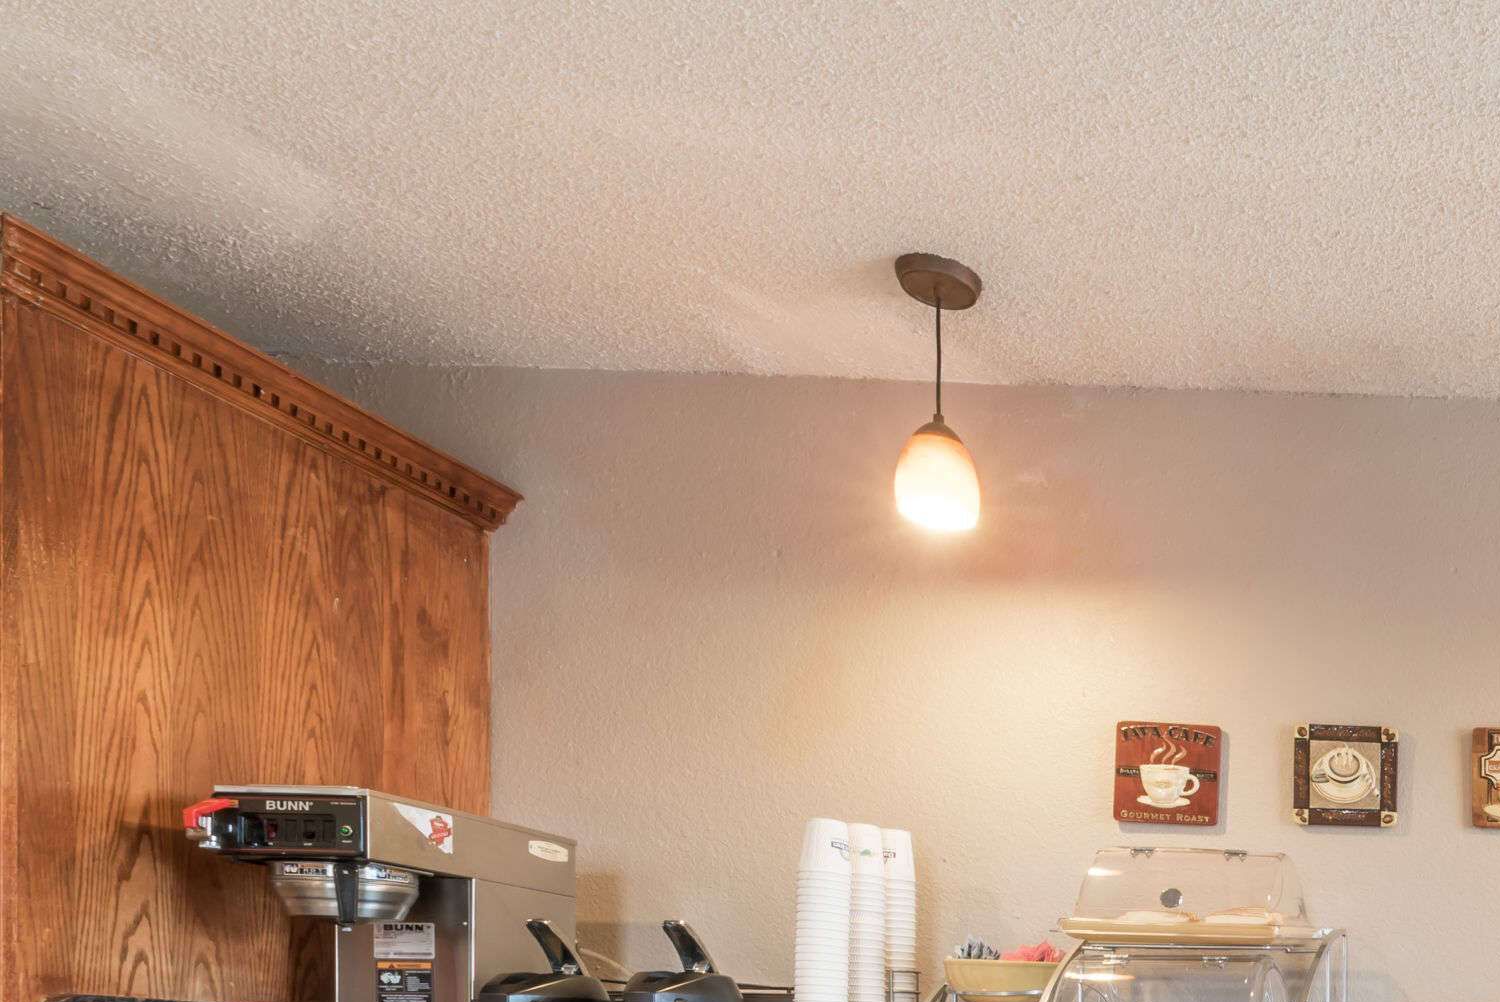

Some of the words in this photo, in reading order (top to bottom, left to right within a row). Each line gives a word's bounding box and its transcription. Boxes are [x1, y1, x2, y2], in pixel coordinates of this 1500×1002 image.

[265, 800, 310, 811] BUNN
[1120, 809, 1171, 821] GOURMET
[1176, 813, 1211, 823] ROAST
